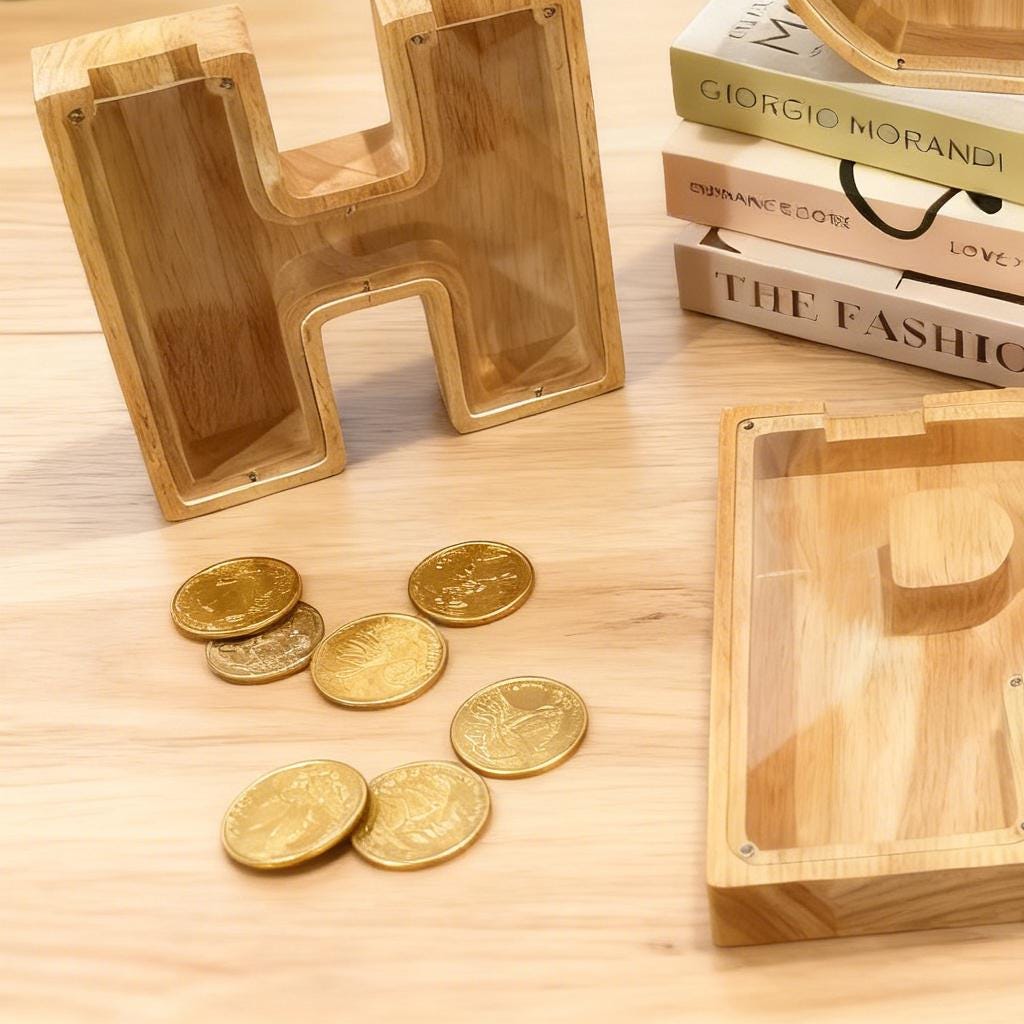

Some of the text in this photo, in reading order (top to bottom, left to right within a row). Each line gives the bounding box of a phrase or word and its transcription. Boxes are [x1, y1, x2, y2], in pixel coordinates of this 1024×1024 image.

[700, 79, 1004, 173] GIORGIO MORANDI
[715, 271, 819, 322] THE
